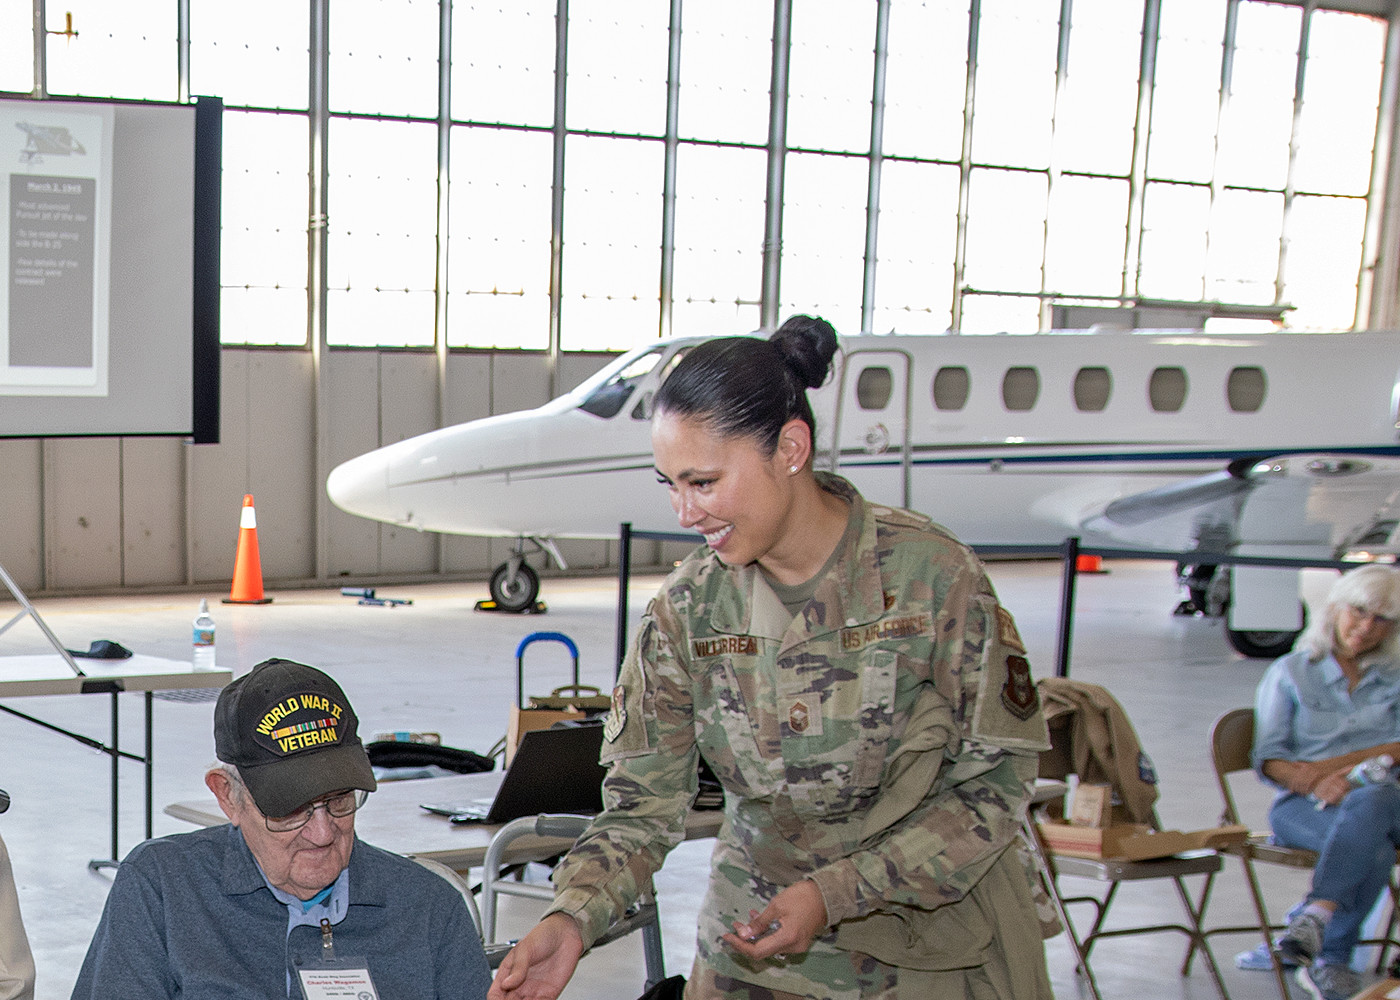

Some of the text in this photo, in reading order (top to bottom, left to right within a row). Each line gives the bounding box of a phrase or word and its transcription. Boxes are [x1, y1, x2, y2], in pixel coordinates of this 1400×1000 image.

[842, 631, 861, 649] US
[256, 694, 344, 736] WORLD WAR II
[278, 727, 338, 753] VETERAN
